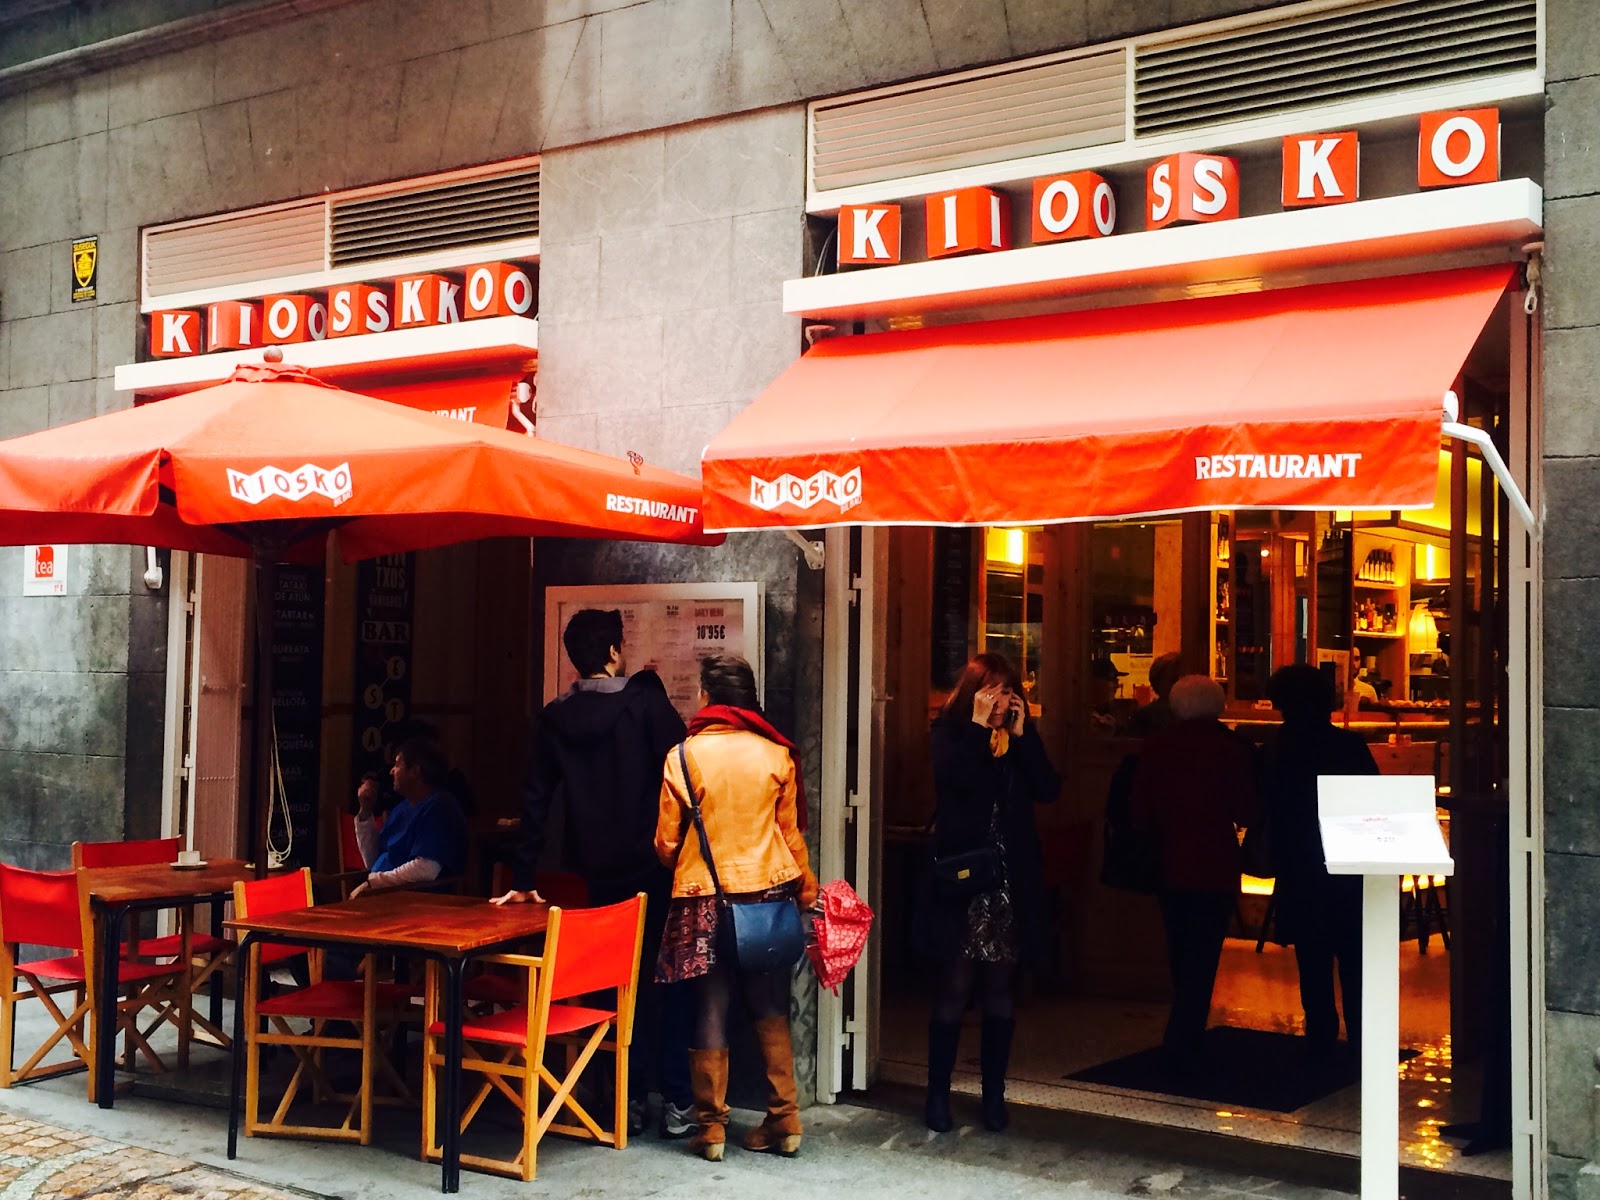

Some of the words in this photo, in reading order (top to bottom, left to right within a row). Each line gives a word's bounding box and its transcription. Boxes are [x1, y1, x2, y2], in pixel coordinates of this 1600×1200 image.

[1194, 452, 1363, 480] RESTAURANT
[232, 469, 348, 498] KIOSKO
[754, 474, 859, 505] KIOSKO
[605, 493, 699, 525] RESTAURANT
[36, 559, 53, 575] tea
[363, 622, 409, 641] BAR
